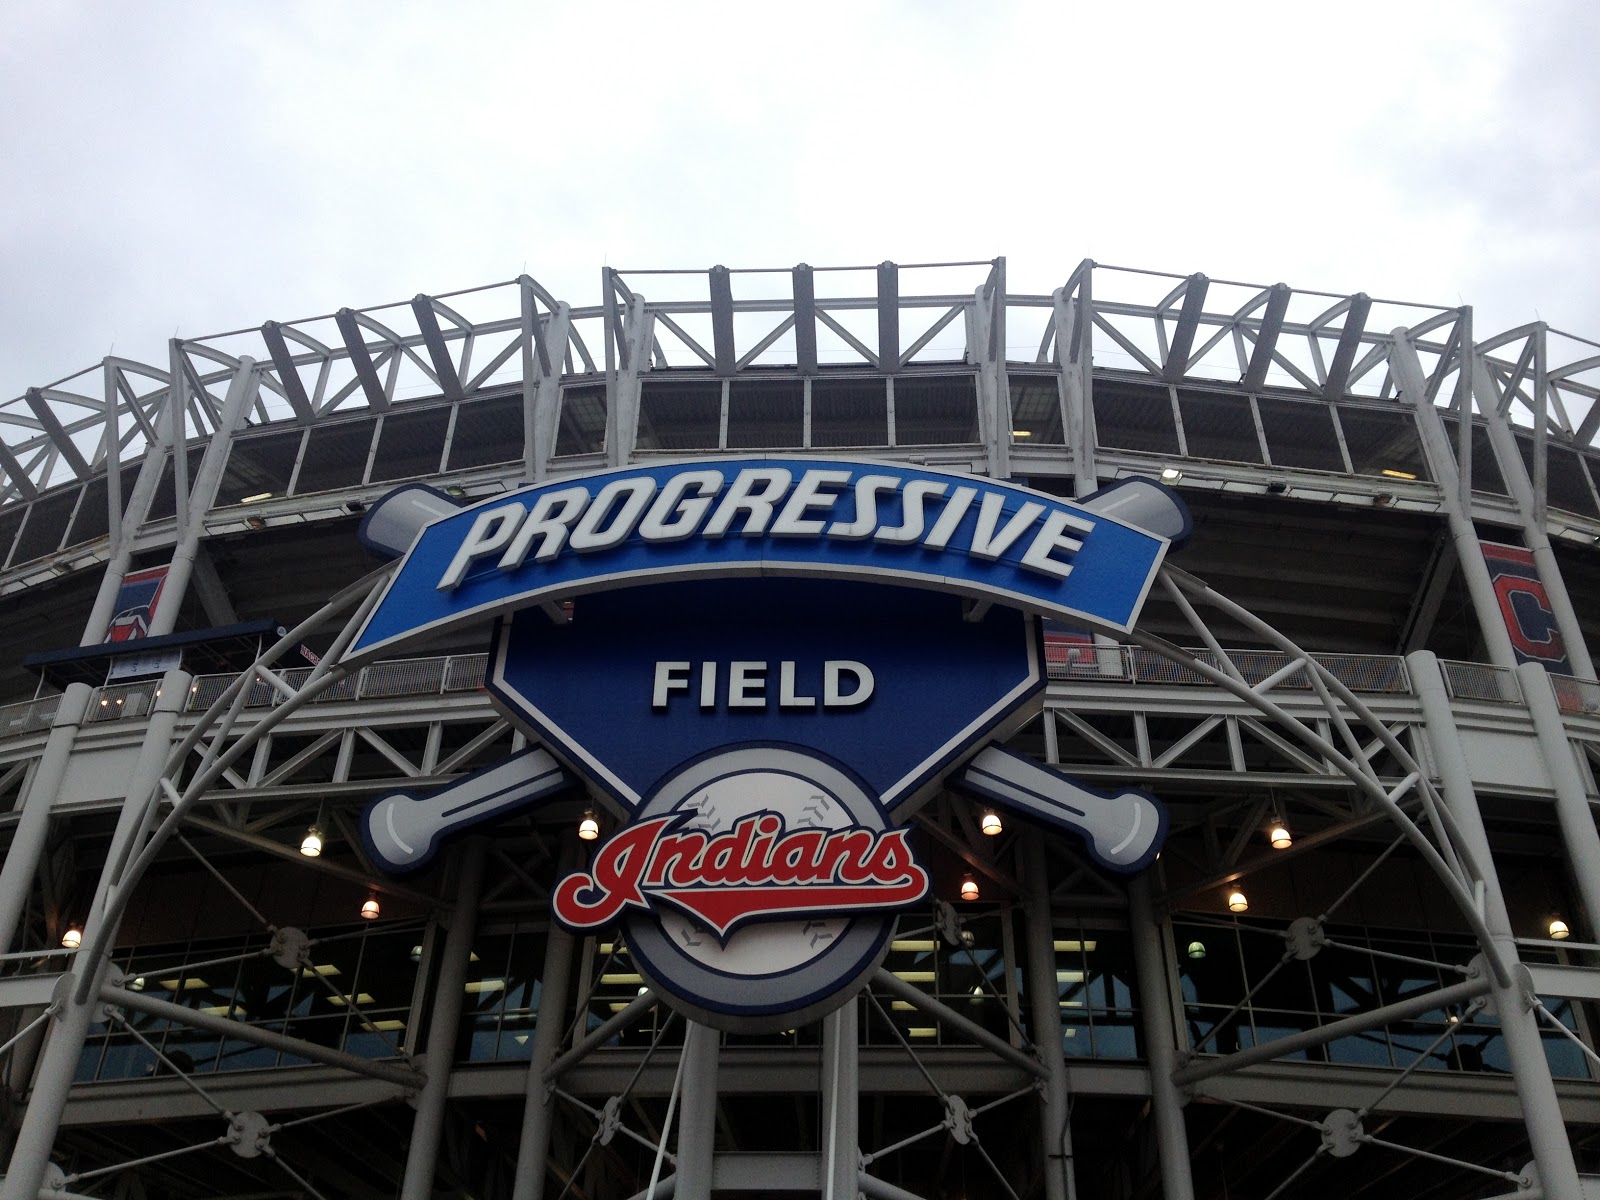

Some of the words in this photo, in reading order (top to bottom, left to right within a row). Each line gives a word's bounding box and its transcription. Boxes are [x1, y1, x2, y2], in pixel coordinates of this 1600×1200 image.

[437, 467, 1096, 591] PROGRESSIVE
[1494, 574, 1566, 663] C
[652, 660, 875, 707] FIELD
[552, 811, 930, 928] Indians
